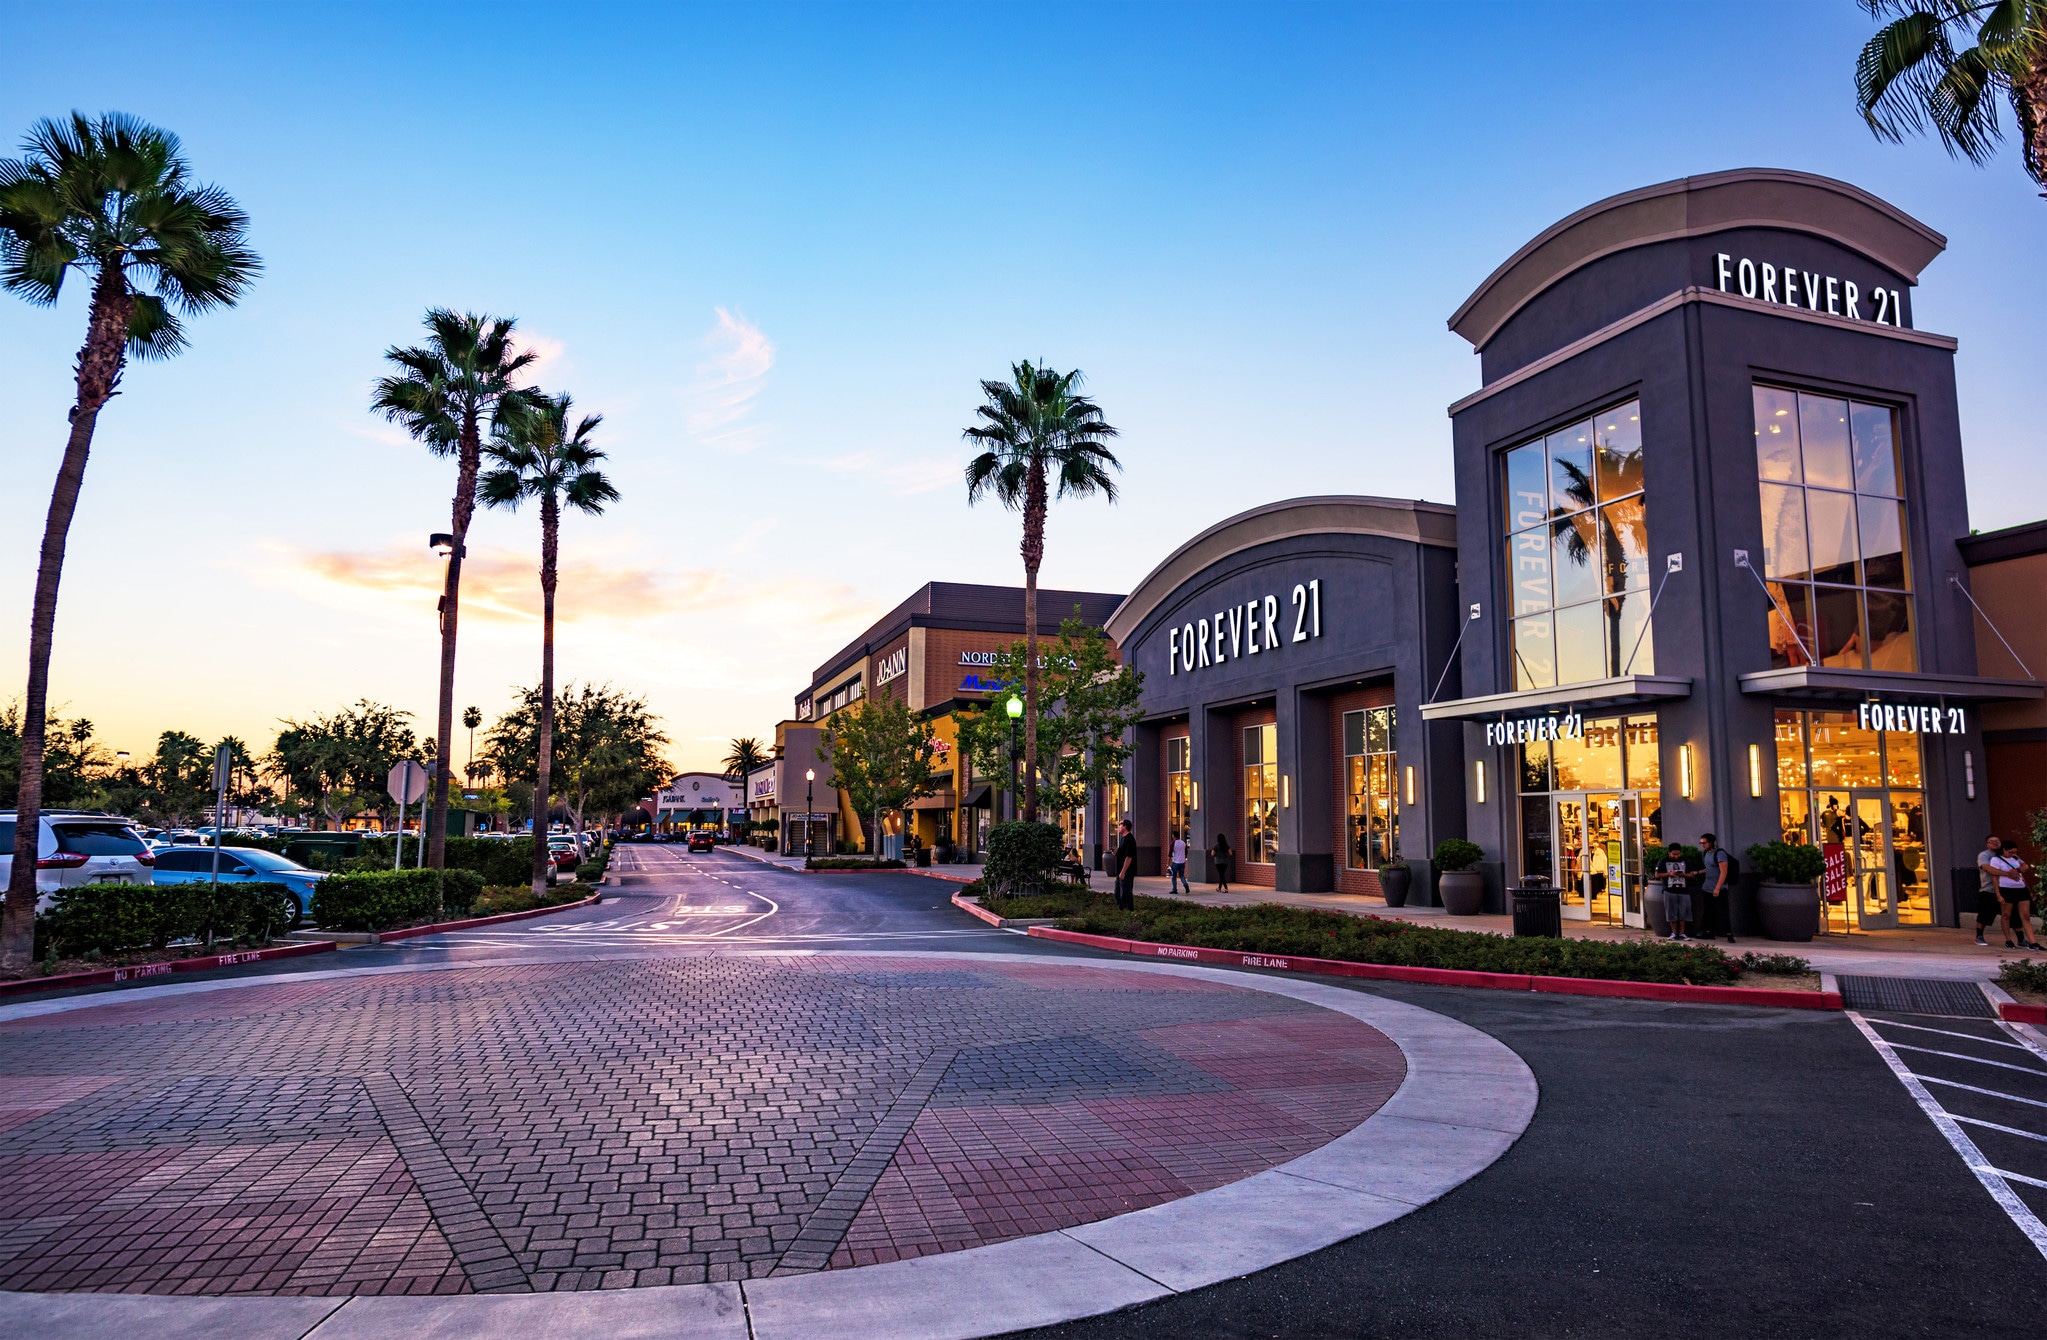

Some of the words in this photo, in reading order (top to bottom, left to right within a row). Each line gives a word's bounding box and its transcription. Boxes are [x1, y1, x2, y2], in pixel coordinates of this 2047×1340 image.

[1718, 253, 1860, 319] FOREVER
[1874, 287, 1901, 327] 21
[1517, 491, 1550, 639] FOREVER
[1170, 594, 1279, 675] FOREVER
[1292, 579, 1319, 643] 21
[1860, 703, 1942, 734] FOREVER
[1948, 708, 1967, 734] 21
[1487, 717, 1559, 746] FOREVER
[1565, 713, 1584, 740] 21
[1824, 851, 1845, 869] SALE
[1825, 864, 1846, 883] SALE
[1826, 877, 1847, 897] SALE
[218, 955, 238, 966] FIRE
[241, 951, 261, 963] LANE
[1158, 947, 1168, 955] NO
[1168, 948, 1199, 959] PARKING
[1242, 955, 1262, 967] FIRE
[1263, 957, 1288, 968] LANE
[114, 969, 128, 982] NO
[134, 963, 172, 979] PARKING
